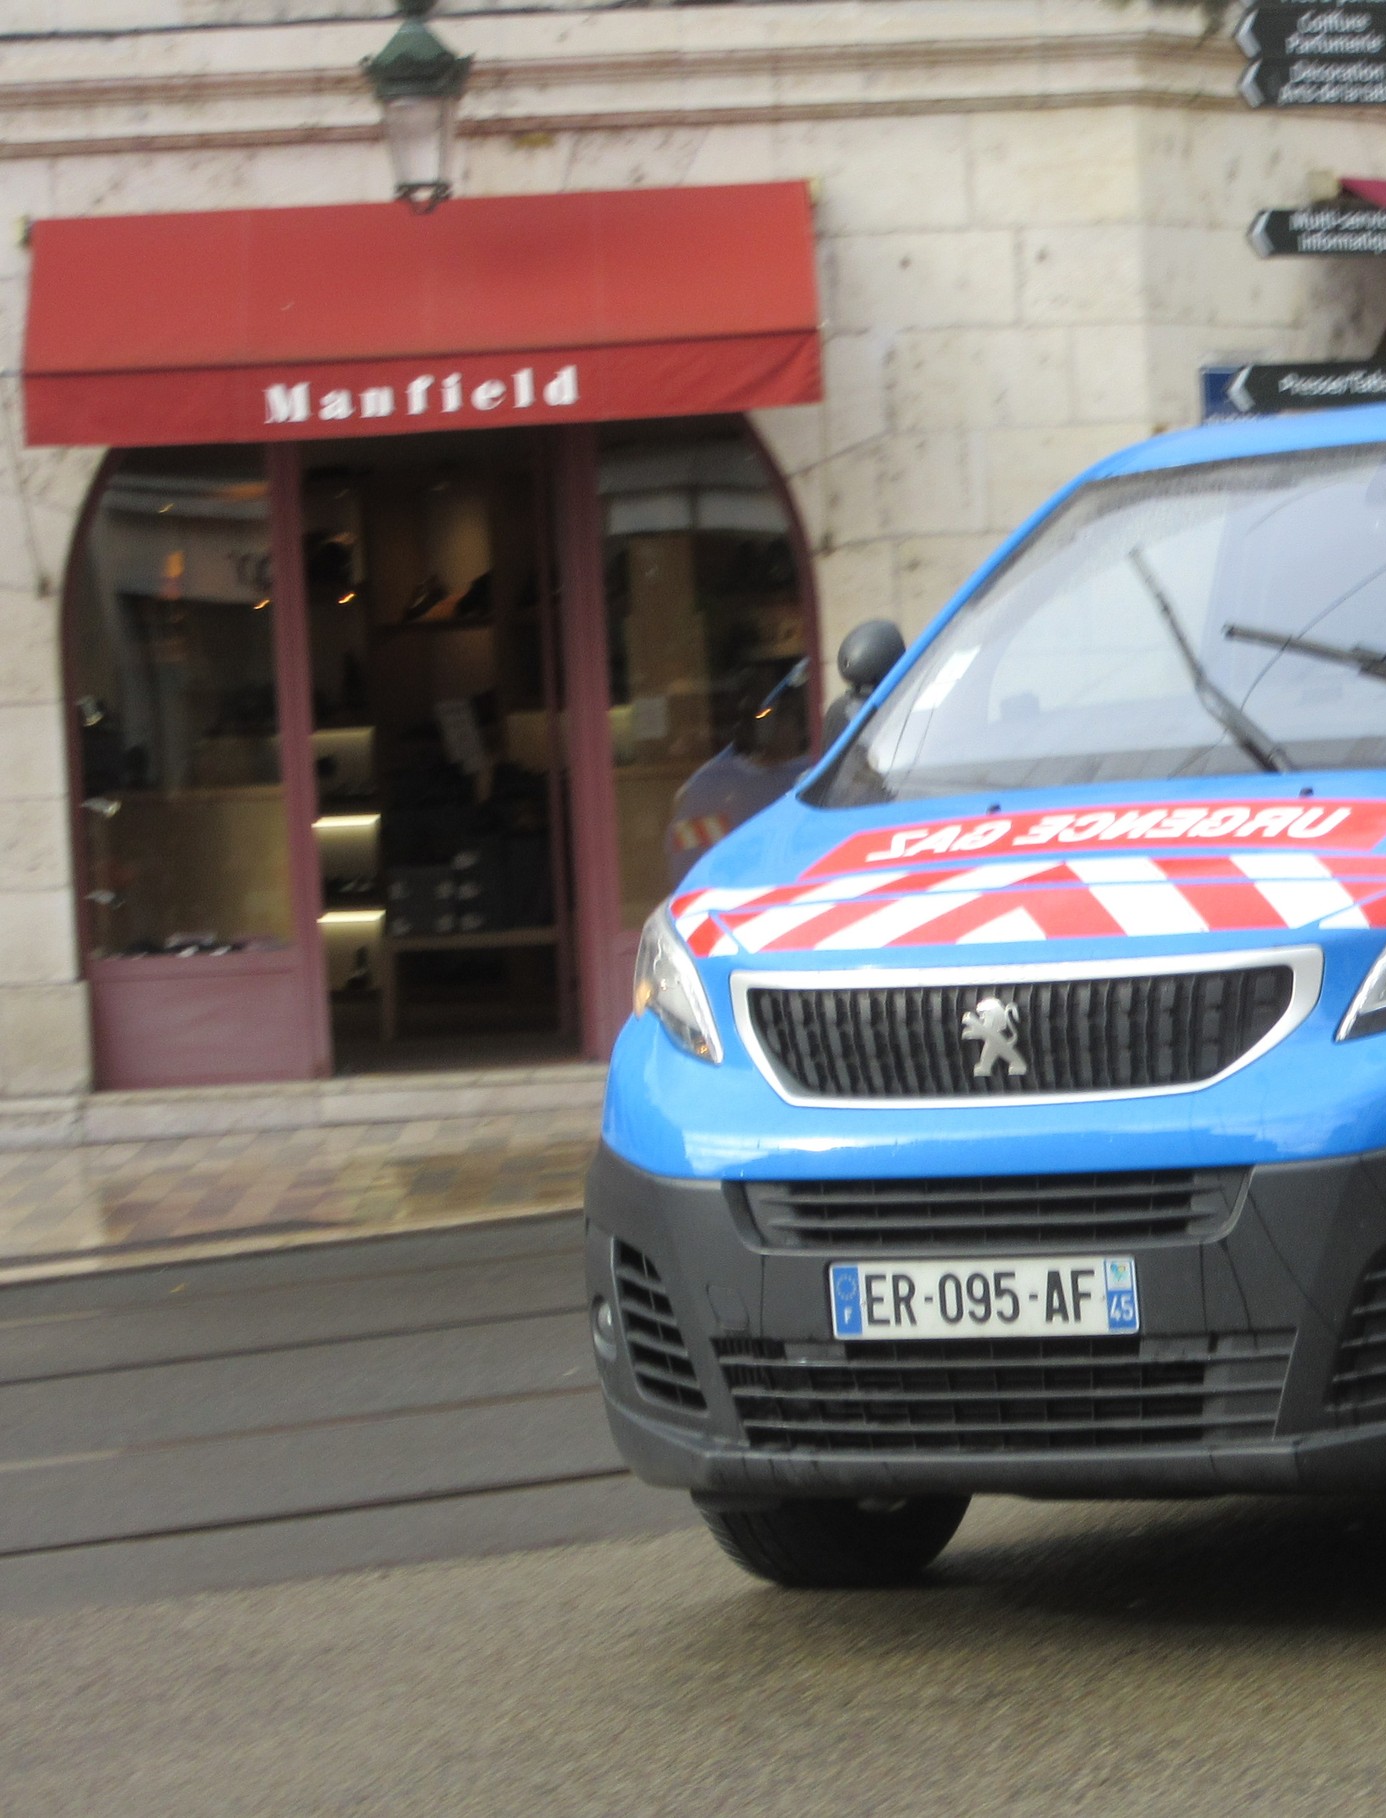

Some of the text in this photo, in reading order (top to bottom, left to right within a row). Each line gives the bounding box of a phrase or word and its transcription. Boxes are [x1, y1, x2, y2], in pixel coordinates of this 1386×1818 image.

[263, 364, 580, 424] Manfield
[843, 1308, 853, 1325] F
[864, 1269, 1095, 1326] ER-095-AF
[1109, 1294, 1134, 1322] 45
